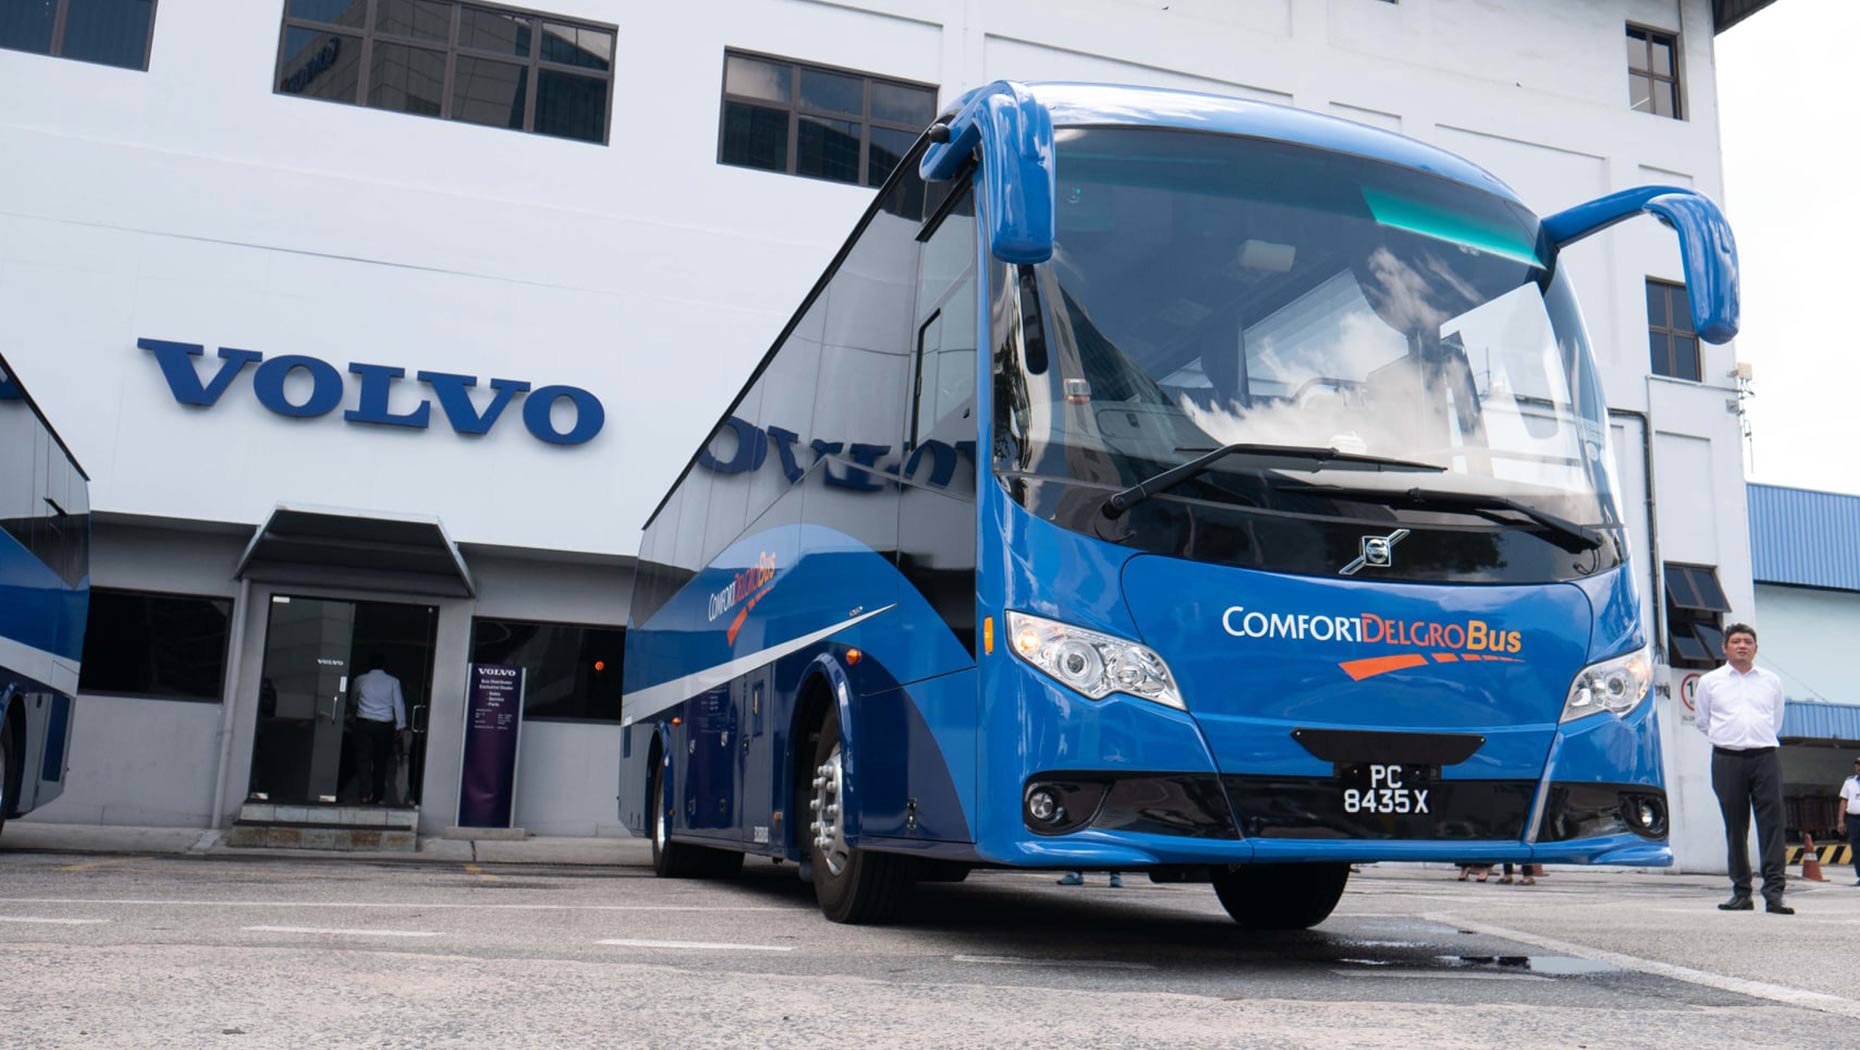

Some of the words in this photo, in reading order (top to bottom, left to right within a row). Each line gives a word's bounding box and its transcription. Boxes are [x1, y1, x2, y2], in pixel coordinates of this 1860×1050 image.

[137, 337, 605, 446] VOLVO
[317, 658, 344, 666] VOLVO
[478, 668, 516, 676] VOLVO
[1369, 764, 1403, 789] PC
